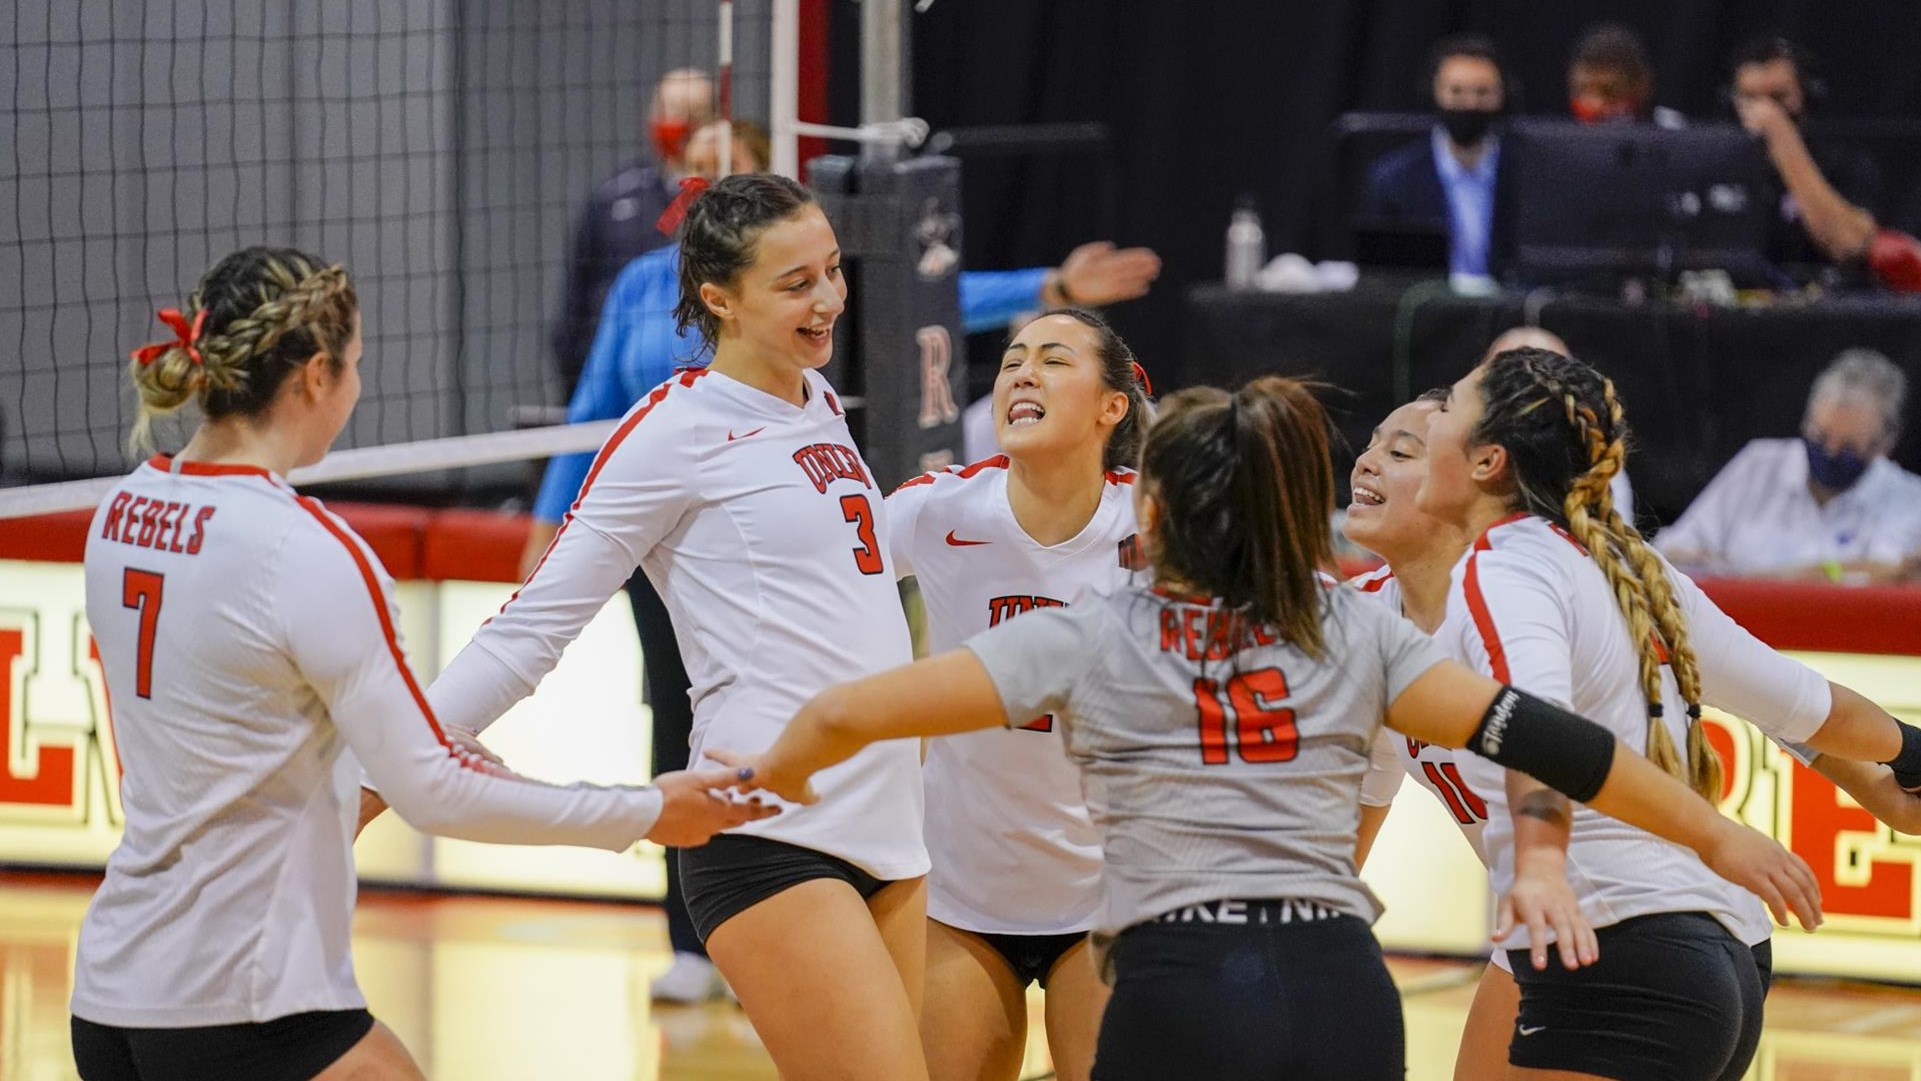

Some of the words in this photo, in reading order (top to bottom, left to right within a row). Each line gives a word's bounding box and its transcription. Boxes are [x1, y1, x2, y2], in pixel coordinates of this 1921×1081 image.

[792, 443, 872, 494] UNLV
[102, 490, 216, 555] REBELS
[840, 494, 884, 575] 3
[122, 566, 164, 700] 7
[1159, 607, 1276, 661] REBL
[1193, 666, 1299, 765] 16
